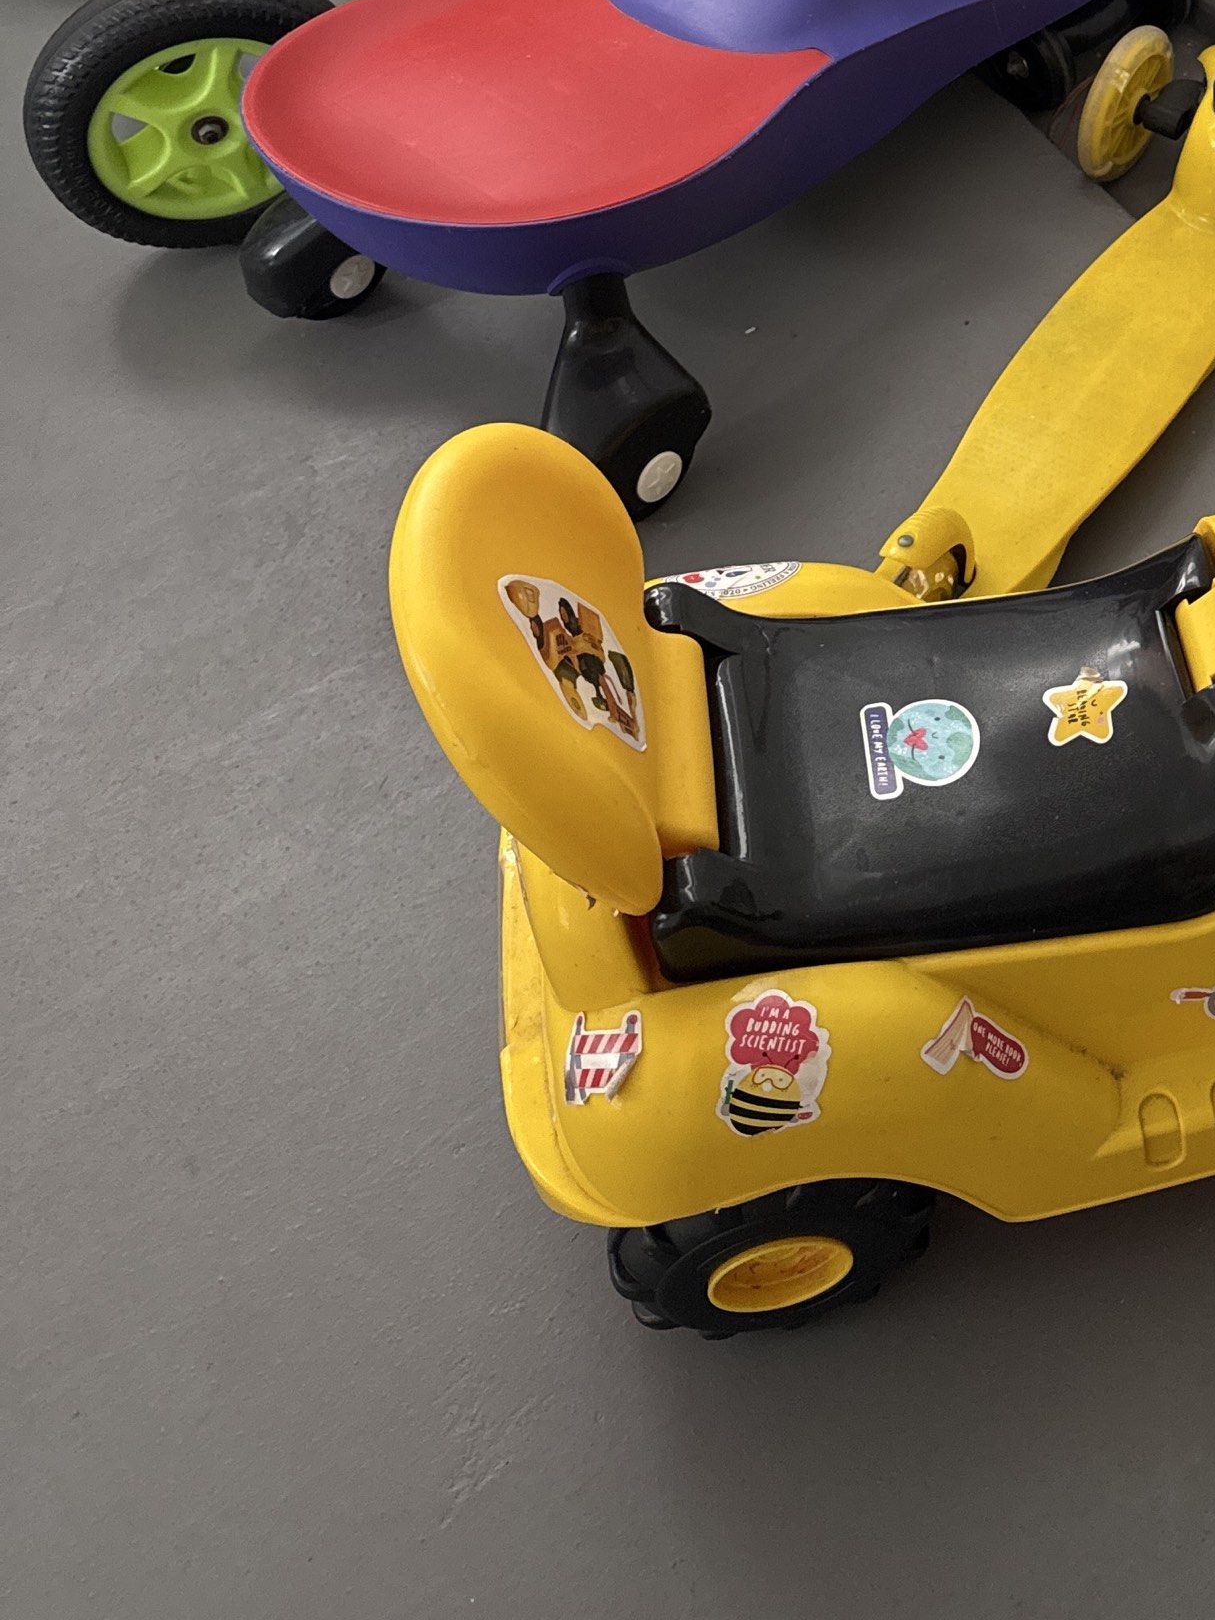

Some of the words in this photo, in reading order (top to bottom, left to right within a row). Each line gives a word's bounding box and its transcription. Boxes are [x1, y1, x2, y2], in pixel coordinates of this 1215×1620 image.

[1067, 702, 1079, 724] STAR
[870, 720, 883, 739] LOVE
[873, 742, 884, 754] MY
[760, 1006, 780, 1018] I'M
[782, 1009, 790, 1020] A
[745, 1017, 801, 1037] BUDDING
[973, 1022, 986, 1038] ONE
[987, 1032, 1005, 1051] MORE
[739, 1034, 807, 1055] SCIENTIST
[985, 1042, 1011, 1066] PLEASE!
